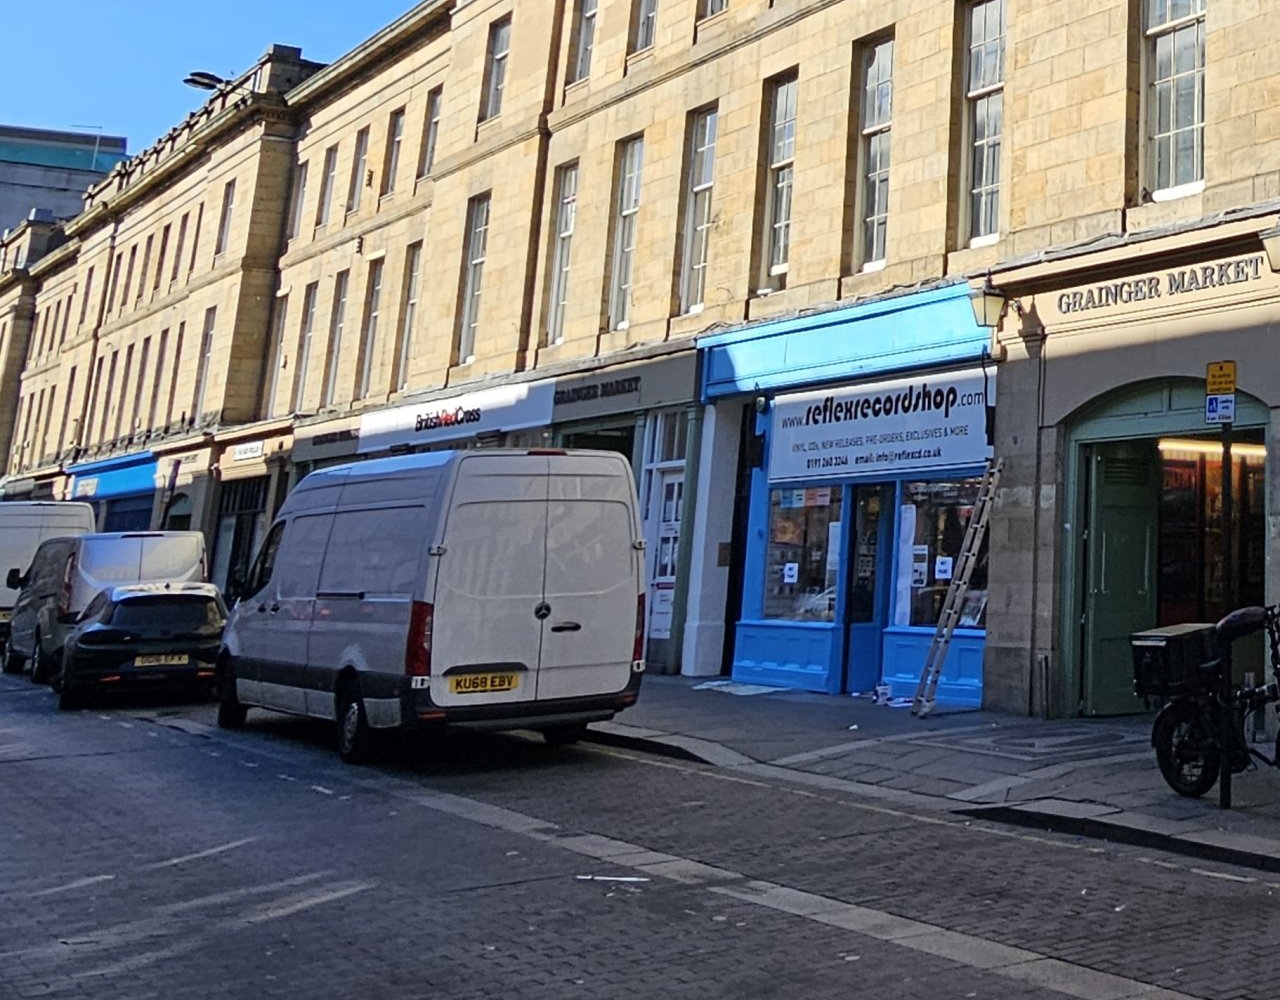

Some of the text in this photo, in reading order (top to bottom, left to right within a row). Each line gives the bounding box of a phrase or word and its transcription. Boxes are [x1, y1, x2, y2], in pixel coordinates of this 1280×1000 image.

[1058, 256, 1264, 314] GRAINGER MARKET
[455, 674, 514, 691] KU68 EBV
